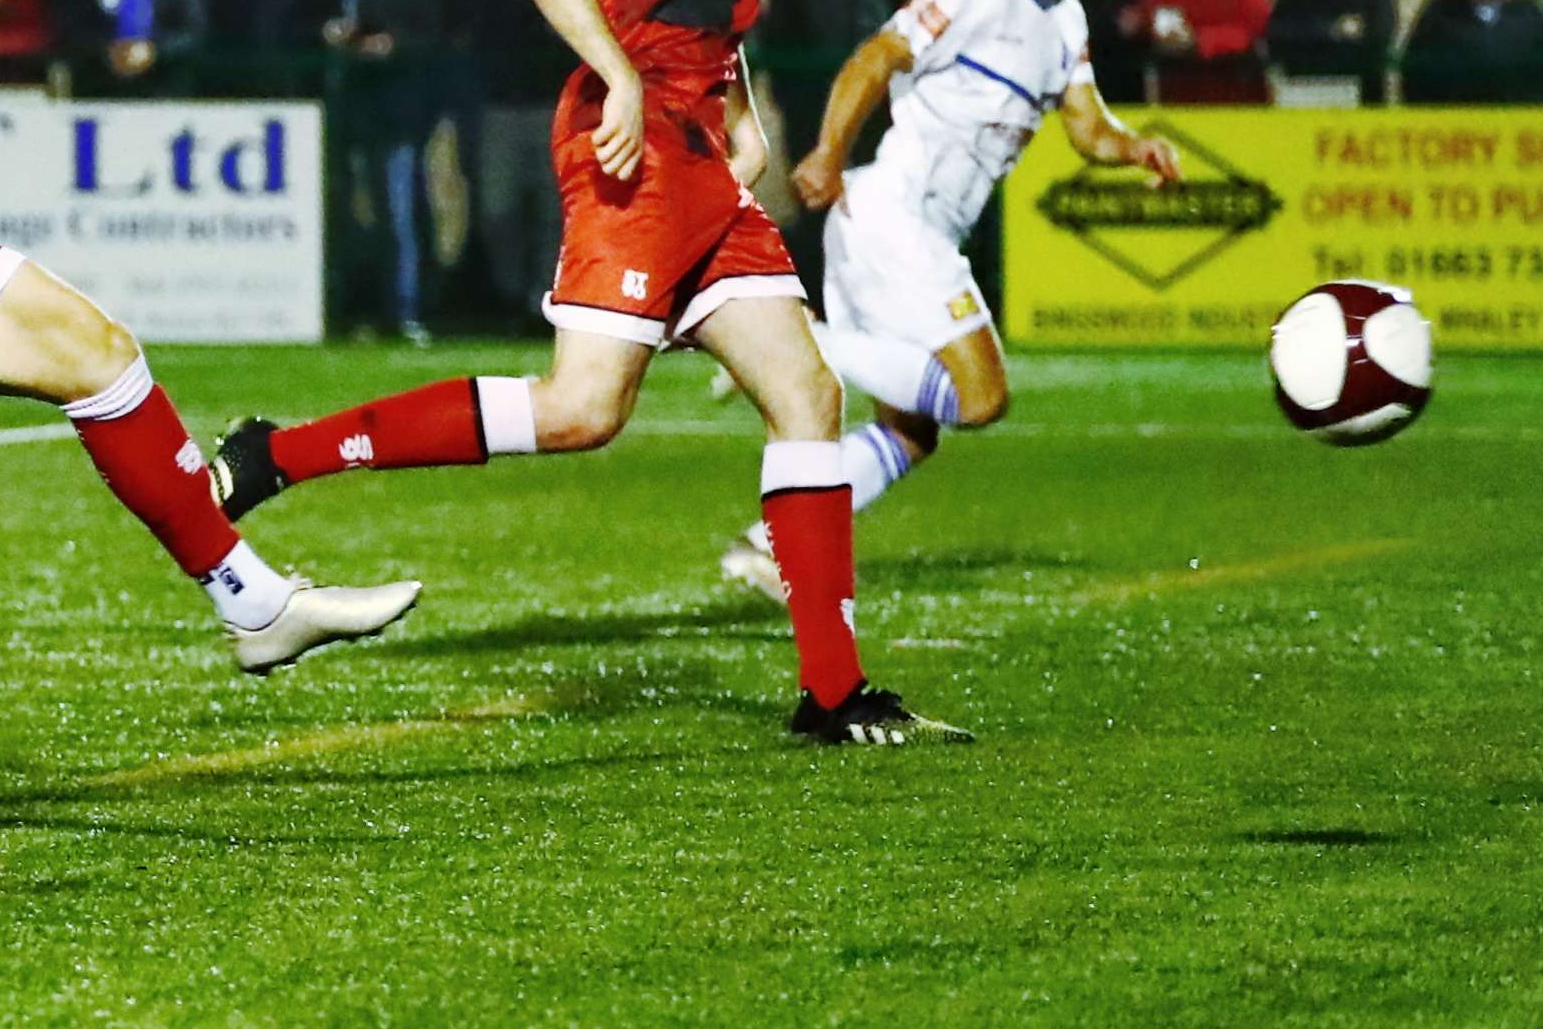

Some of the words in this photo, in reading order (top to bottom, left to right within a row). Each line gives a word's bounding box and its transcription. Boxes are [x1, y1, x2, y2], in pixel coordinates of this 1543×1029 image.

[71, 116, 288, 196] Ltd
[1313, 129, 1498, 166] FACTORY
[1303, 184, 1414, 223] OPEN
[1428, 185, 1480, 223] TO
